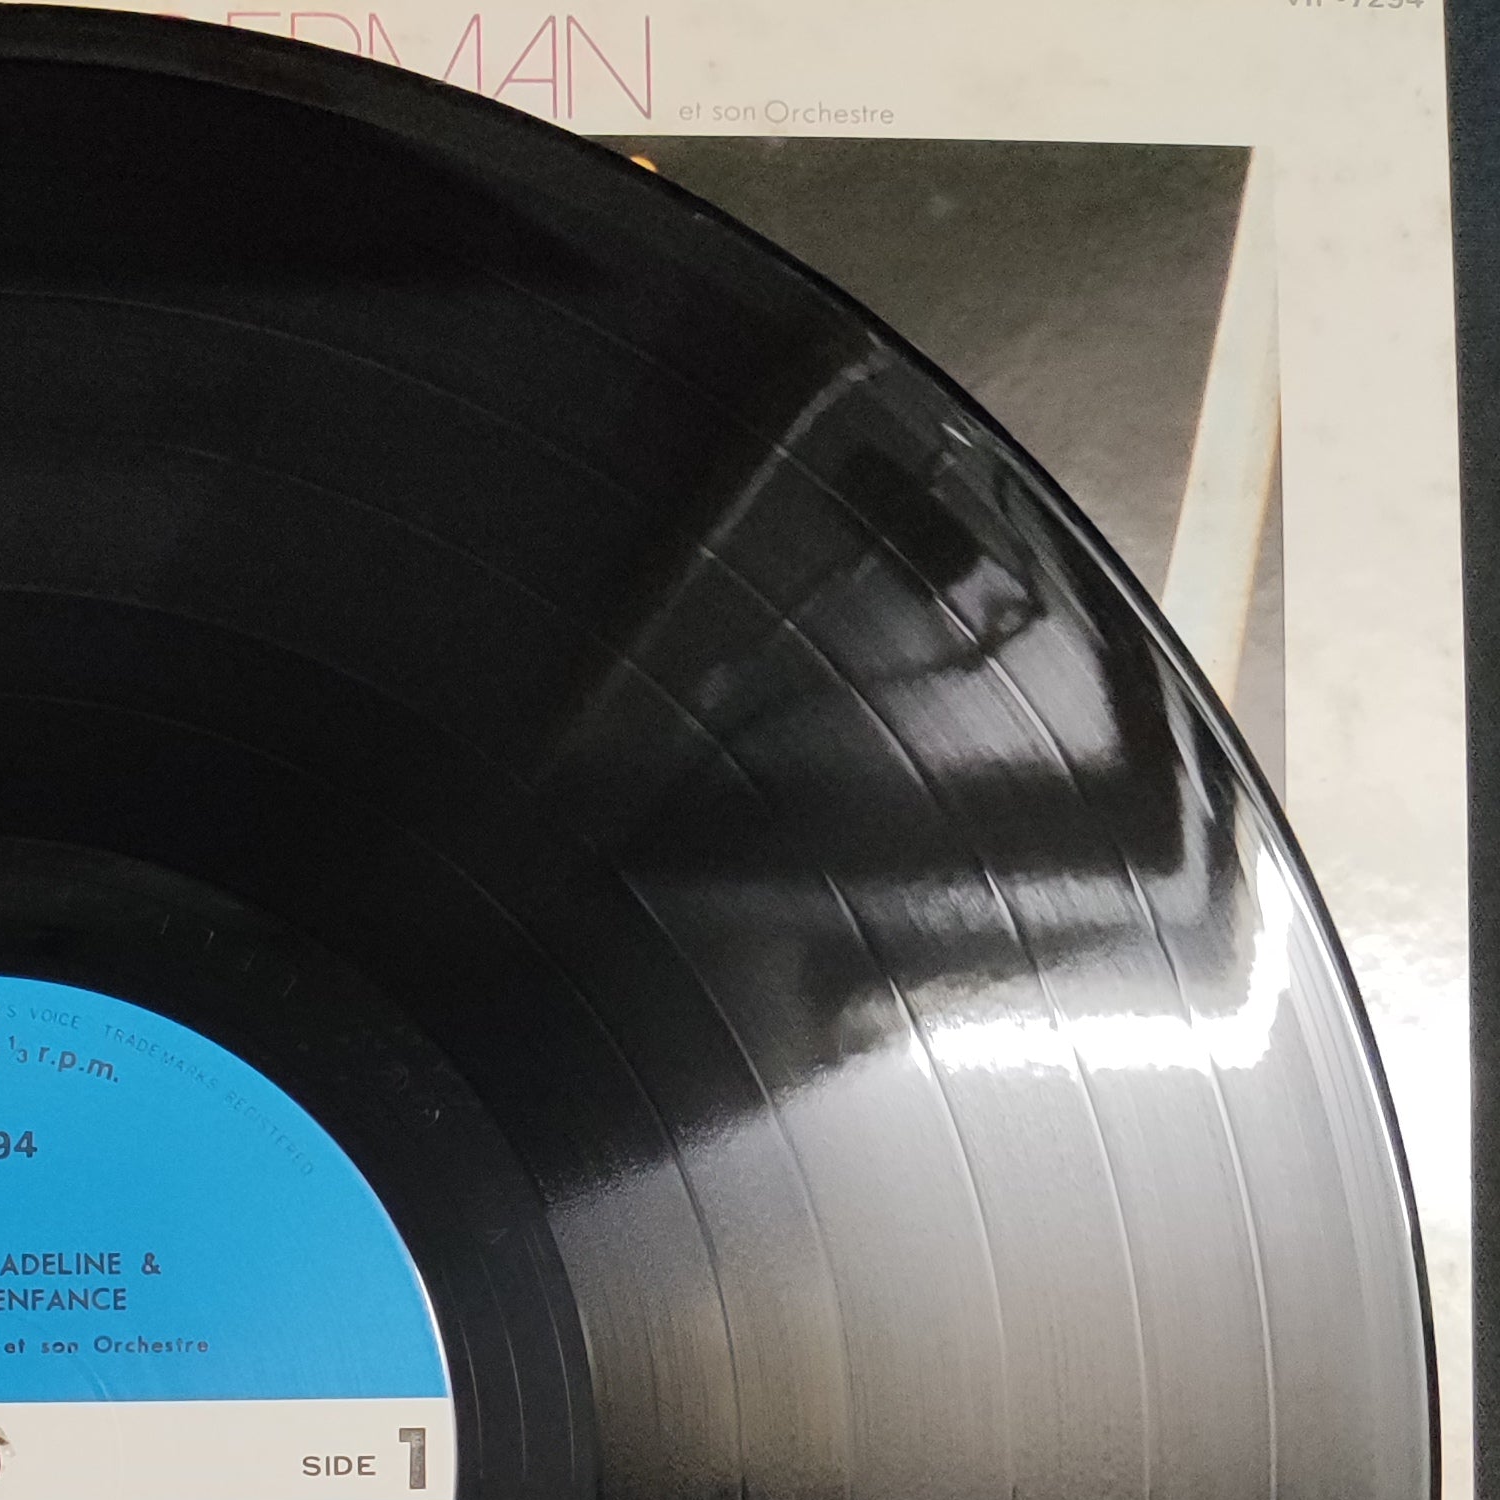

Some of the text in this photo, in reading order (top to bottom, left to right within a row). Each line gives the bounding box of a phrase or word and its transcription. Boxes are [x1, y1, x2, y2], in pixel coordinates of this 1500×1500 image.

[679, 99, 895, 126] et son Orchestre
[29, 1006, 83, 1030] VOICE
[0, 1252, 122, 1276] ADELINE
[141, 1252, 162, 1275] &
[4, 1338, 26, 1354] et
[41, 1340, 80, 1354] son
[93, 1335, 210, 1354] Orchestre
[302, 1427, 427, 1490] SIDE 1
